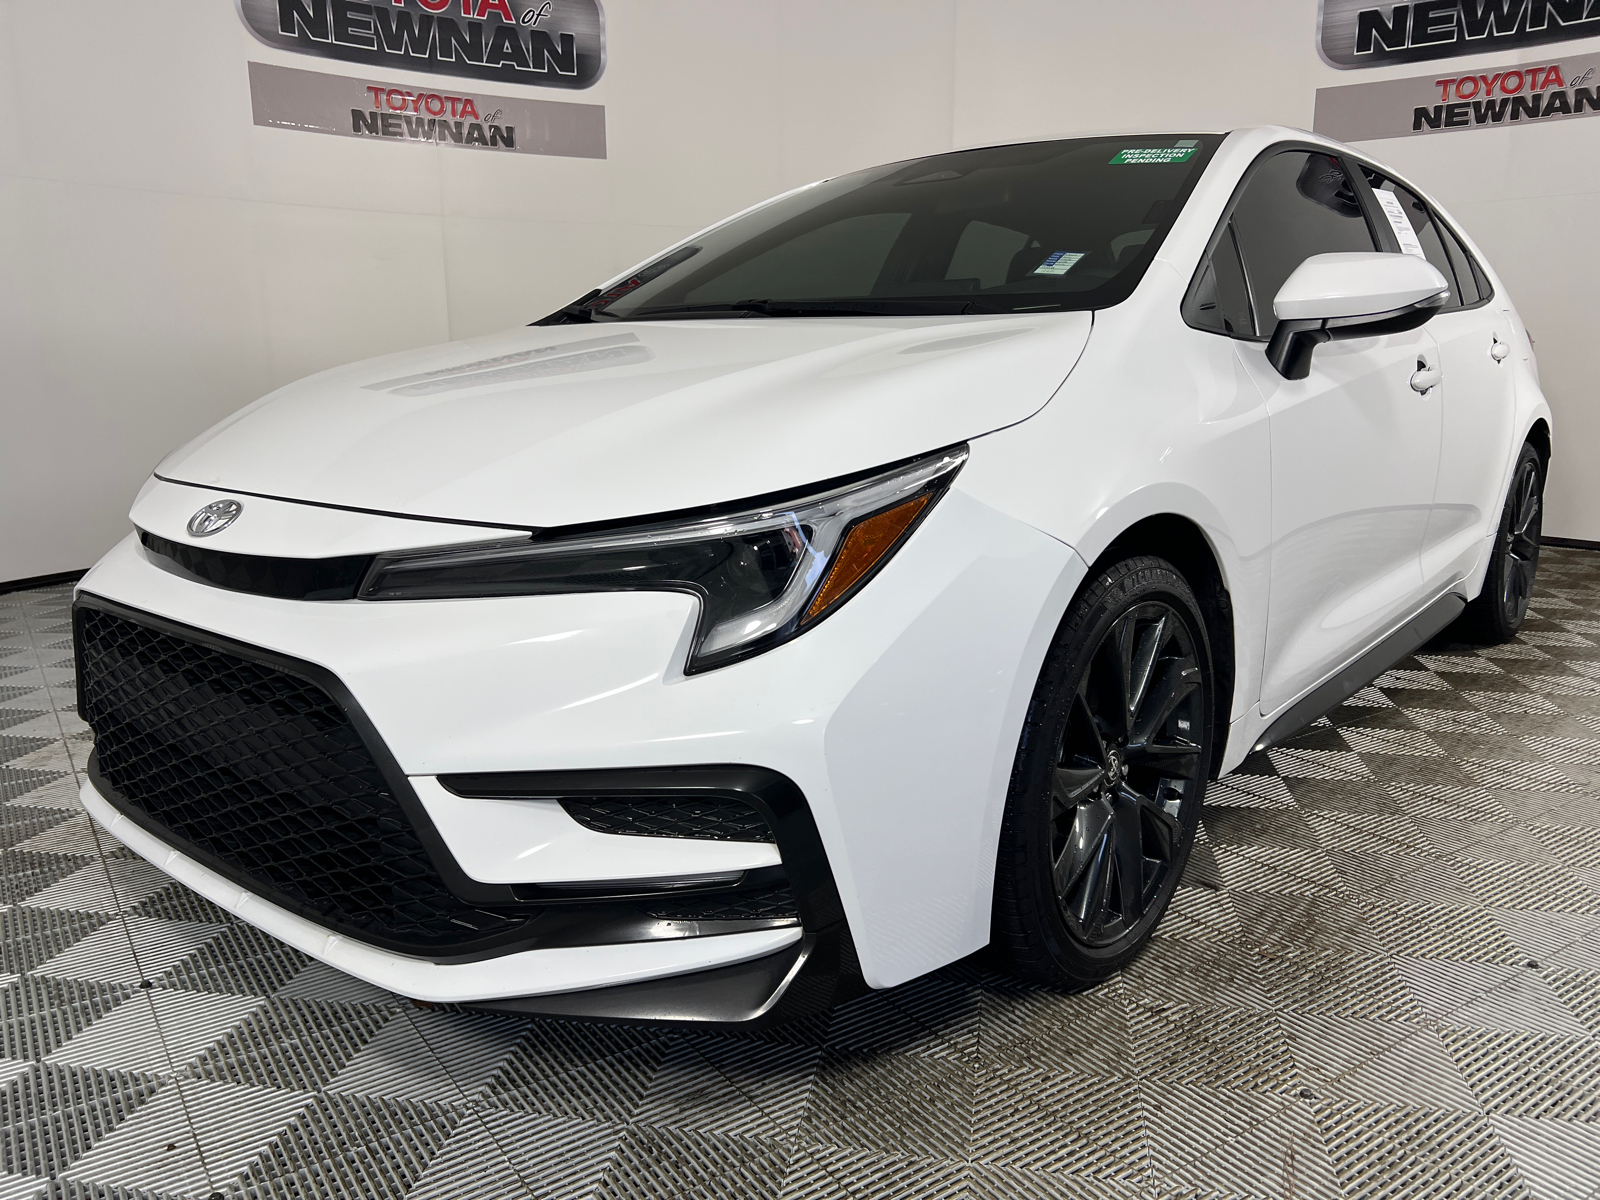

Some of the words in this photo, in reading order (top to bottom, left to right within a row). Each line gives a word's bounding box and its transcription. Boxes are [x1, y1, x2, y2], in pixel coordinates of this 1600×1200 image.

[520, 1, 552, 26] of
[276, 0, 577, 75] NEWNAN
[1435, 64, 1566, 102] TOYOTA
[1570, 67, 1595, 88] of
[366, 86, 480, 121] TOYOTA
[484, 109, 501, 123] of
[1412, 85, 1600, 132] NEWNAN
[350, 108, 516, 149] NEWNAN
